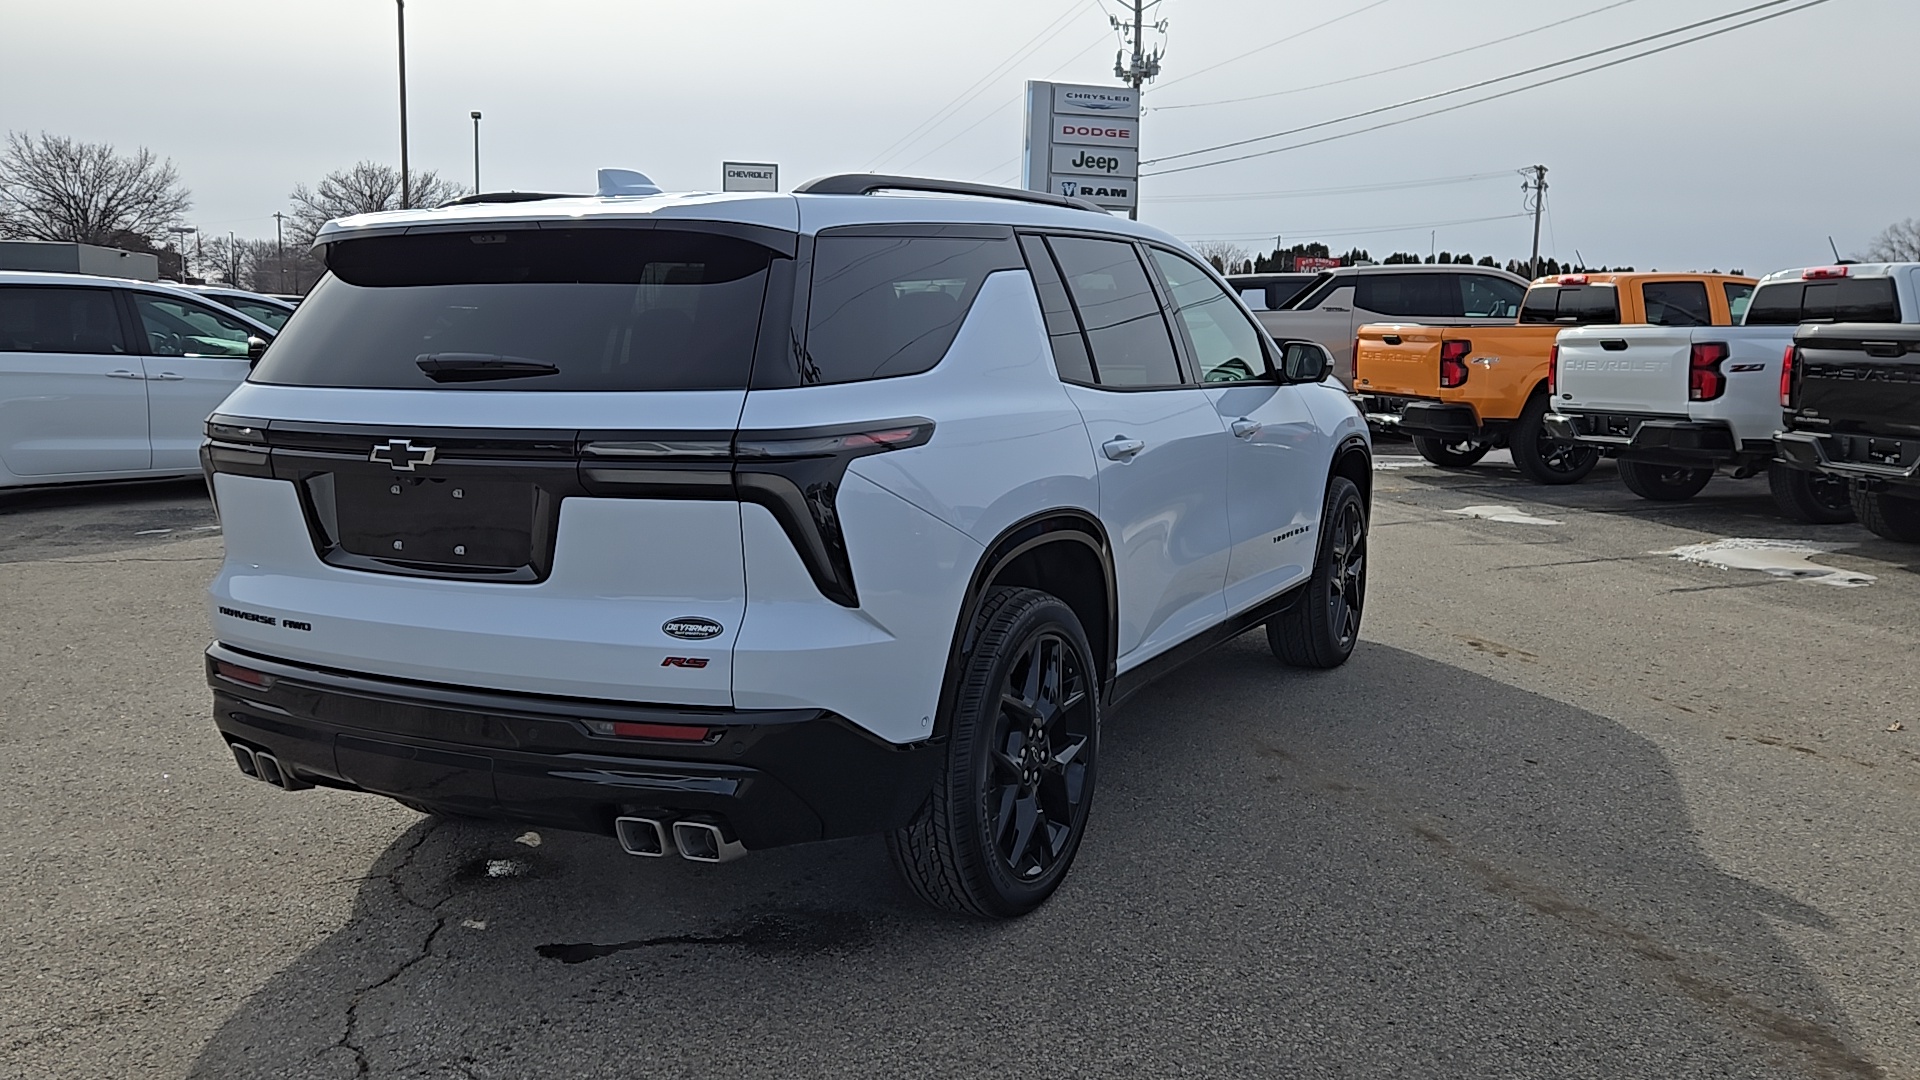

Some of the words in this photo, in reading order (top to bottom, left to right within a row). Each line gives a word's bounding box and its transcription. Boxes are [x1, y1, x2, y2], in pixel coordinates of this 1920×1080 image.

[1065, 92, 1130, 102] CHRYSLER
[1062, 126, 1130, 138] DODGE
[1071, 150, 1119, 173] Jeep
[727, 170, 773, 179] CHEVROLET
[1080, 186, 1127, 198] RAM
[1361, 351, 1427, 363] CHEVROLET
[1564, 361, 1669, 372] CHEVROLET
[218, 606, 276, 626] TRAVERSE
[665, 623, 720, 633] DEYARMAN
[661, 656, 710, 668] RS
